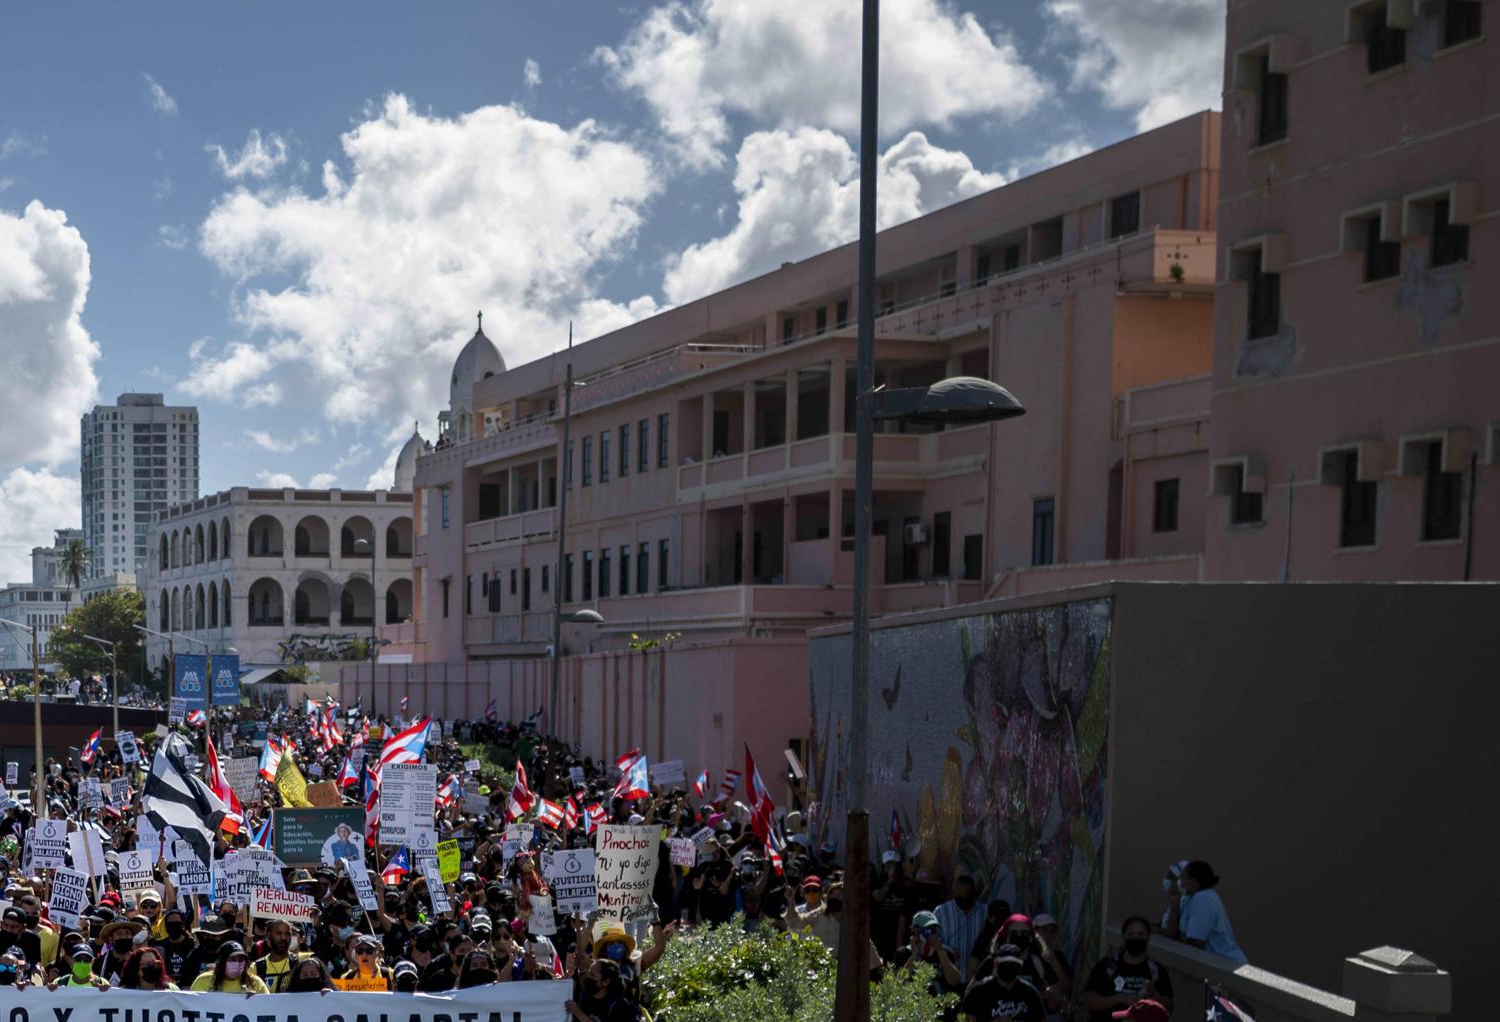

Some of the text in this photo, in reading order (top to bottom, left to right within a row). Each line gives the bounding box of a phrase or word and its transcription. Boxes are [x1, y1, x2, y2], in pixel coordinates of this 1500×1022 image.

[34, 839, 66, 847] JUSTICIA
[602, 830, 649, 850] Pinocho:
[120, 871, 153, 880] JUSTICIA
[620, 860, 630, 880] yo
[55, 872, 85, 887] RETIRO
[181, 874, 209, 884] AHORA
[554, 875, 596, 886] JUSTICIA
[54, 884, 83, 901] DIGNO
[256, 889, 309, 903] PIERLUISI
[556, 888, 596, 899] SALARIAL
[52, 897, 79, 911] AHORA
[257, 903, 311, 918] RENUNCIA
